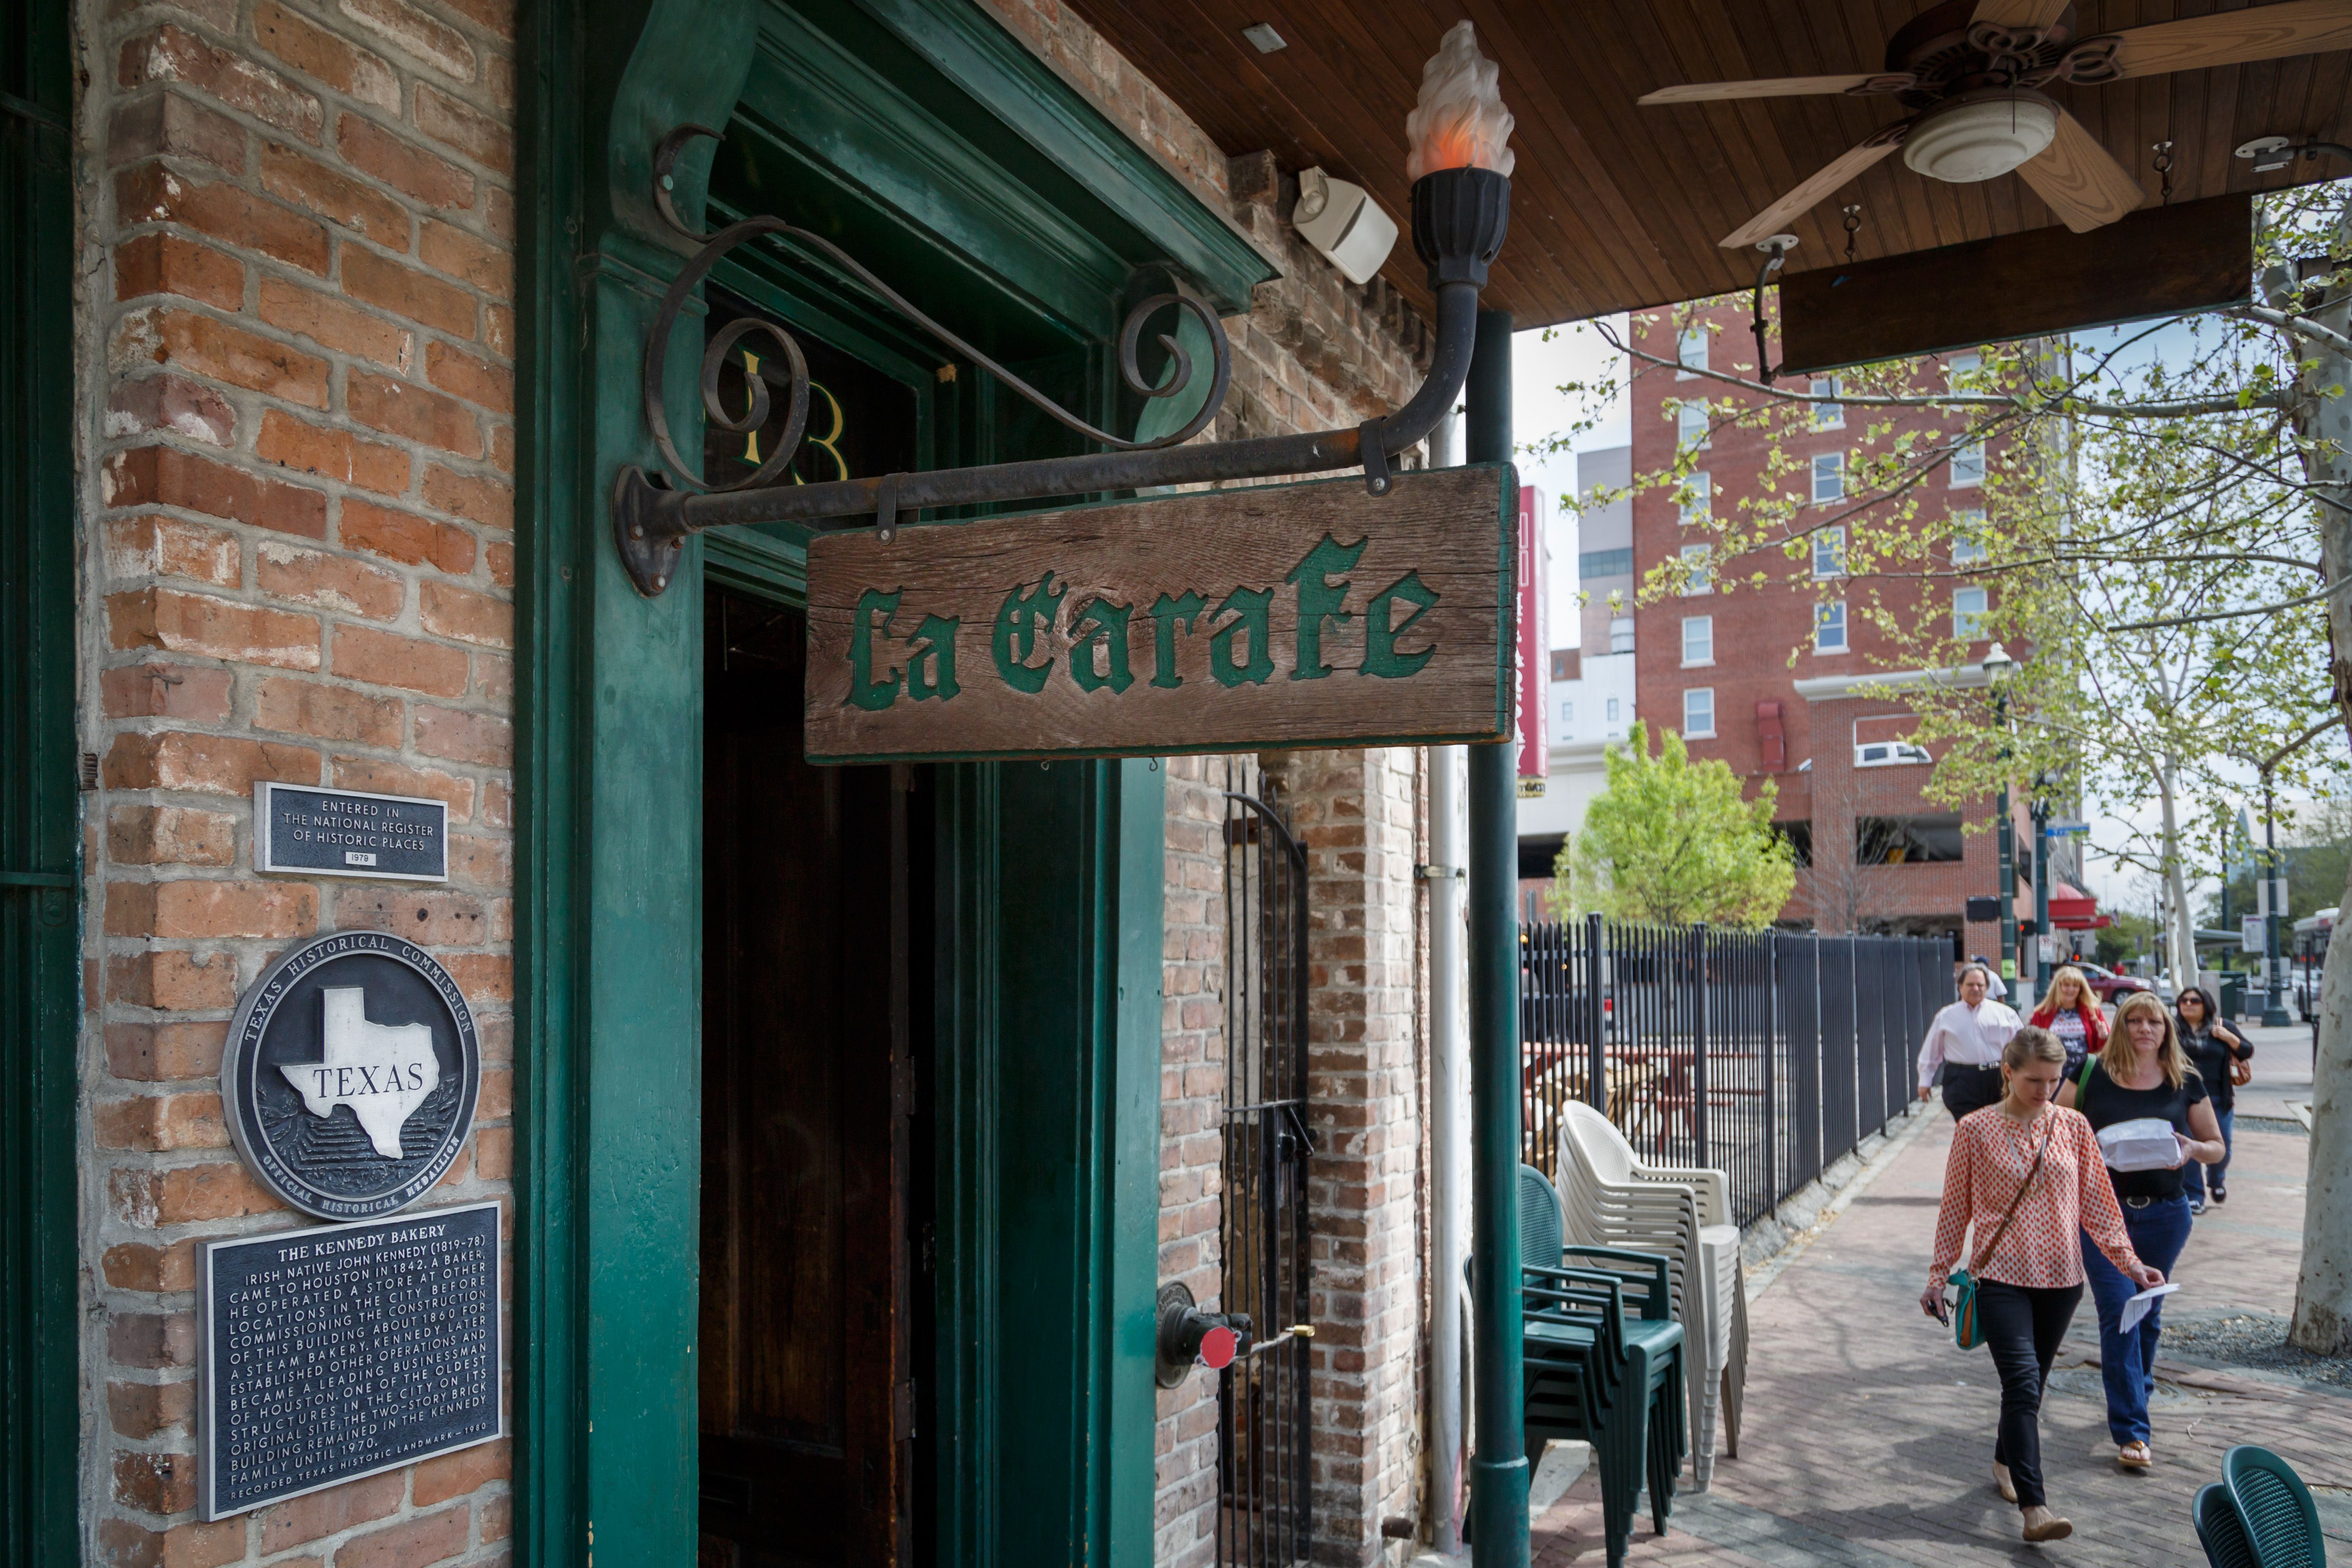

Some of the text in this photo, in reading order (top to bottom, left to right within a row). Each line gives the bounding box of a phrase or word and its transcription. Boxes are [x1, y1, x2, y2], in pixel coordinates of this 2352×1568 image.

[843, 585, 961, 713] La
[991, 532, 1441, 695] Carafe
[283, 813, 433, 836] THE NATIONAL REGISTER
[322, 800, 399, 818] ENTERED IN
[293, 829, 424, 850] OF HISTORIC PLACES
[244, 935, 472, 1040] TEXAS HISTORICAL COMMISSION
[313, 1063, 423, 1099] TEXAS
[263, 1135, 460, 1213] OFFICIAL HISTORICAL MEDALLION
[245, 1234, 485, 1286] IRISH NATIVE JOHN KENNEDY (1819-78)
[278, 1224, 446, 1262] THE KENNEDY BAKERY
[229, 1249, 485, 1304] CAME TO HOUSTON IN 1842. A BAKER,
[229, 1275, 485, 1335] LOCATIONS IN THE CITY BEFORE
[230, 1261, 485, 1319] HE OPERATED A STORE AT OTHER
[230, 1289, 485, 1349] COMMISSIONING THE CONSTRUCTION
[230, 1302, 485, 1364] OF THIS BUILDING ABOUT 1860 FOR
[230, 1315, 485, 1380] A STEAM BAKERY. KENNEDY LATER
[230, 1329, 486, 1395] ESTABLISHED OTHER OPERATIONS AND
[230, 1342, 486, 1411] BECAME A LEADING BUSINESSMAN
[230, 1354, 486, 1425] OF HOUSTON. ONE OF THE OLDEST
[231, 1368, 486, 1441] STRUCTURES IN THE CITY ON ITS
[231, 1381, 486, 1456] ORIGINAL SITE, THE TWO-STORY BRICK
[231, 1394, 486, 1471] BUILDING REMAINED IN THE KENNEDY
[231, 1437, 378, 1485] FAMILY UNTIL 1970.
[231, 1476, 292, 1500] RECORDED
[298, 1464, 333, 1481] TEXAS
[340, 1448, 391, 1469] HISTORIC
